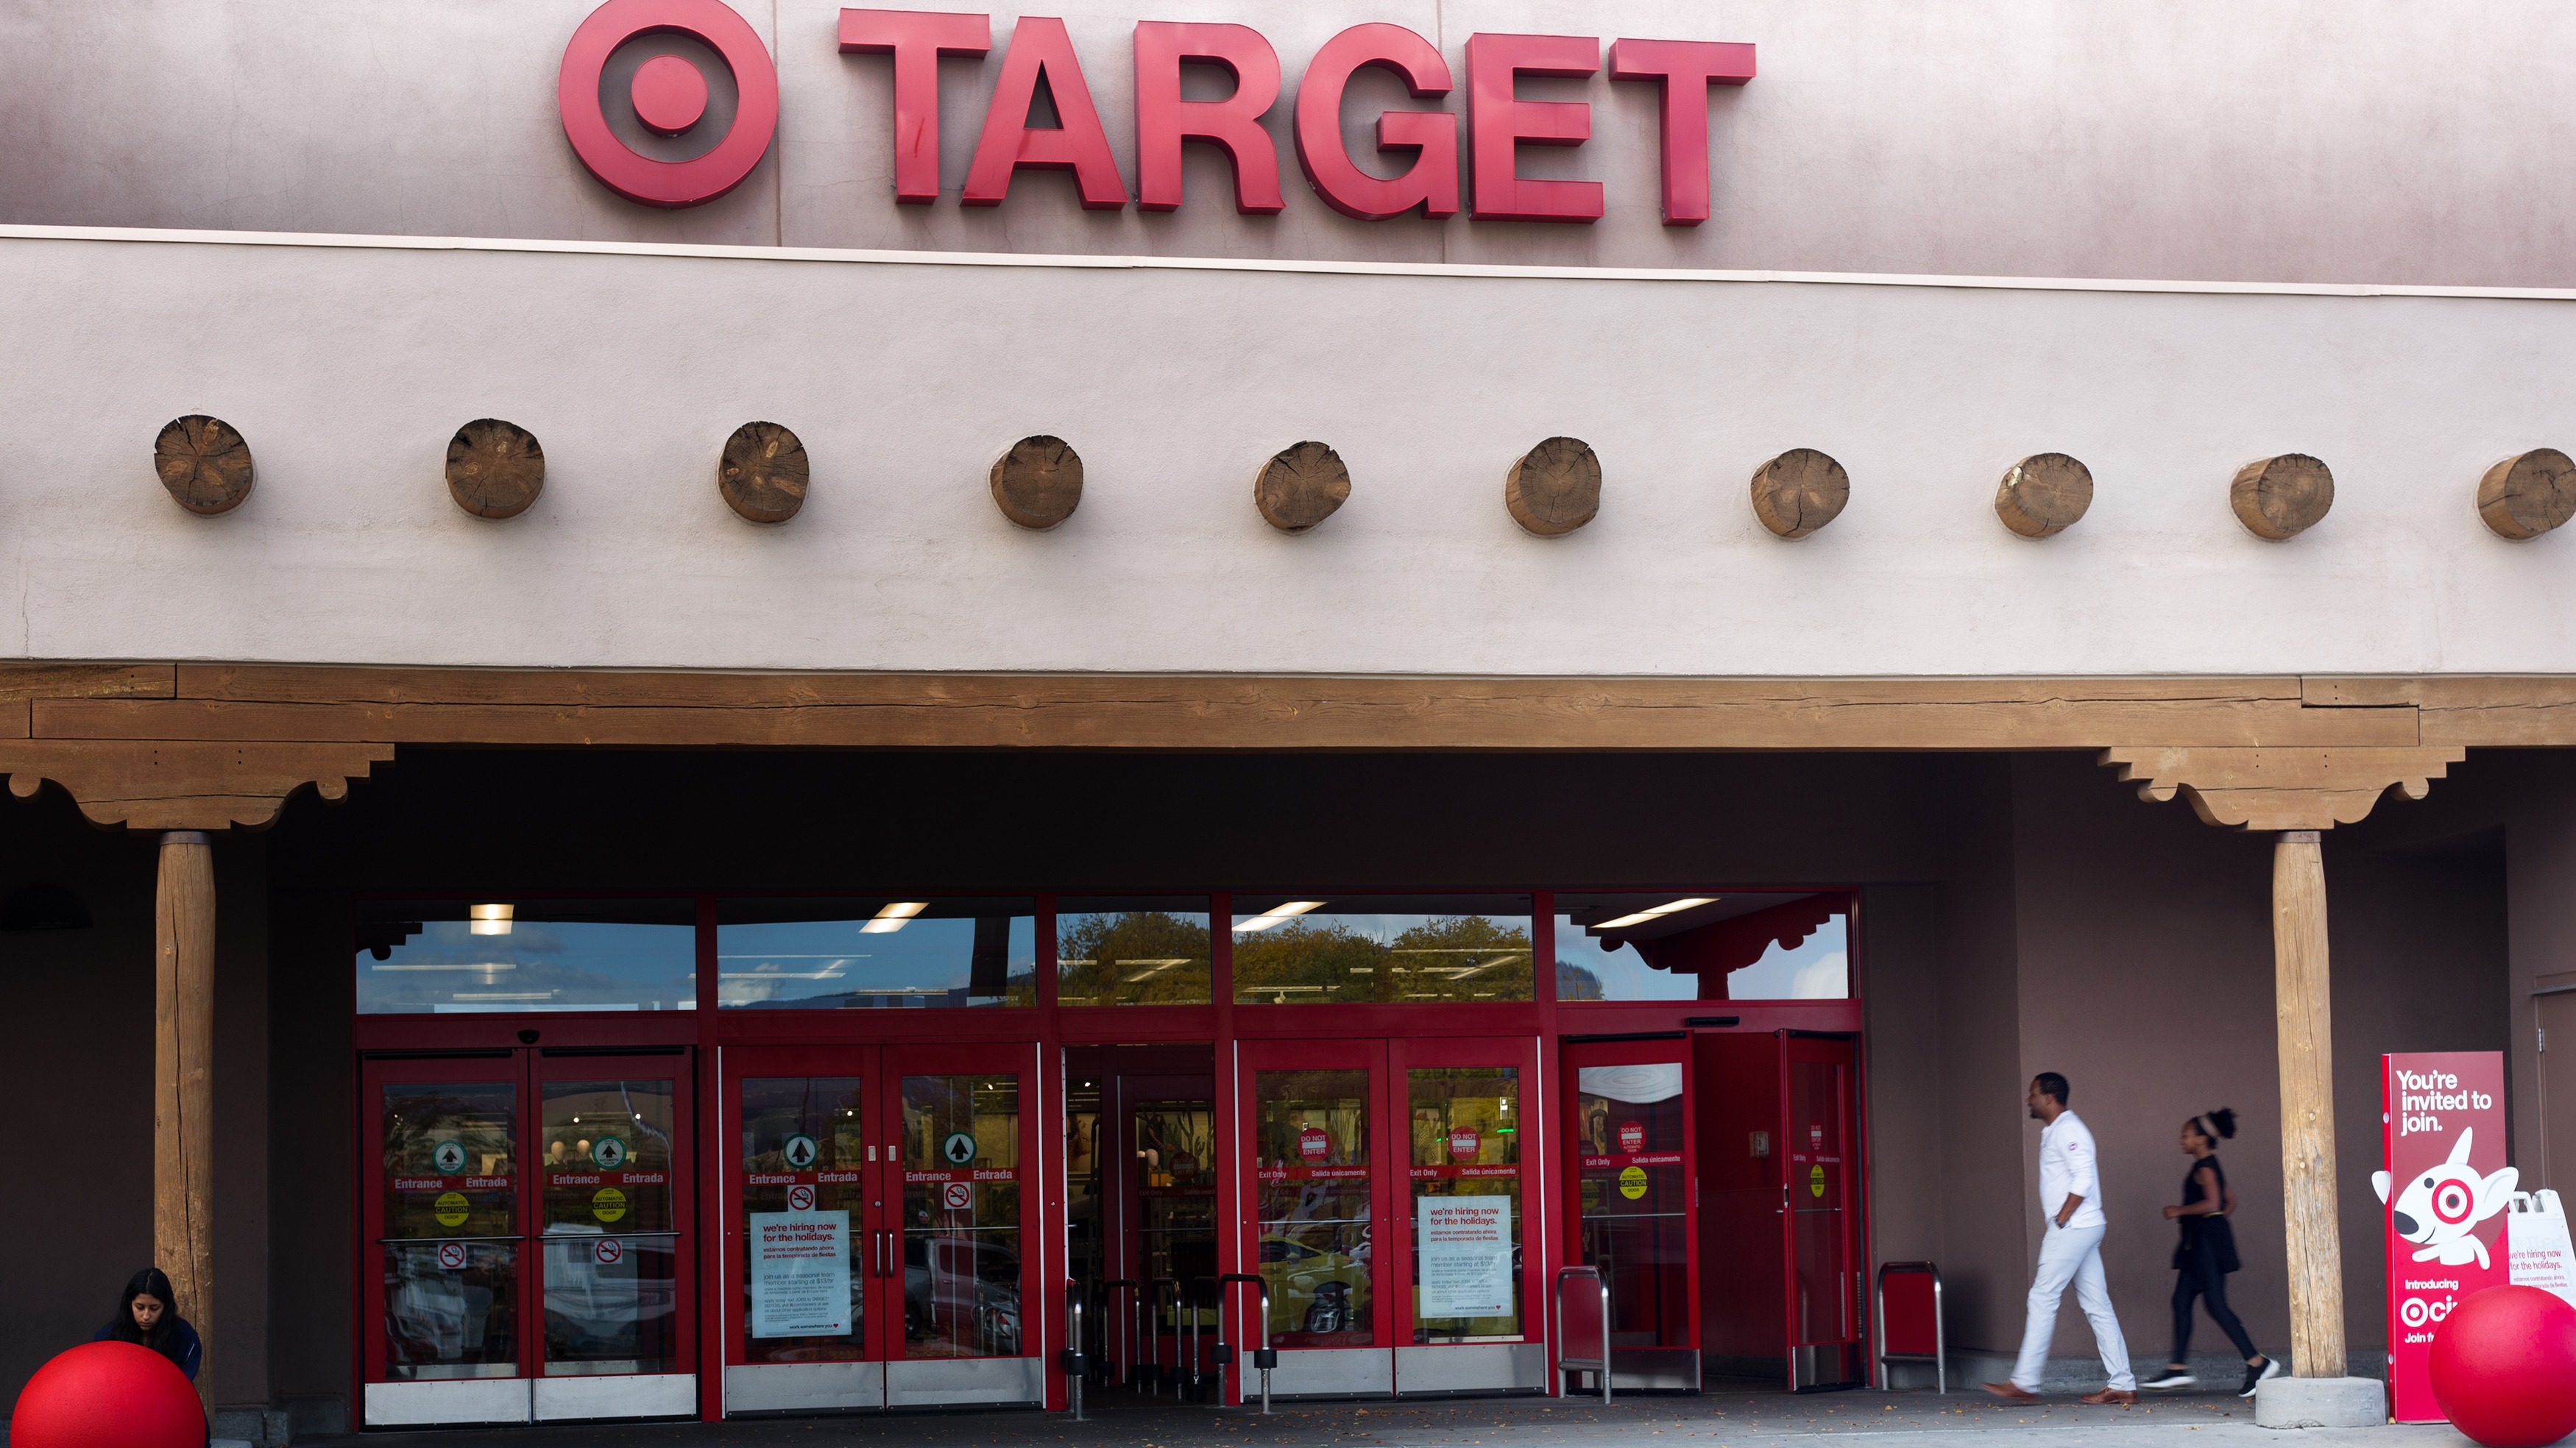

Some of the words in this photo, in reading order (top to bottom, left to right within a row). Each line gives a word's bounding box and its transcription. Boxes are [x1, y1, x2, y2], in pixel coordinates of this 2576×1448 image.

[838, 7, 1757, 226] TARGET
[2396, 1069, 2458, 1090] You're
[2402, 1090, 2468, 1111] invited
[2471, 1090, 2492, 1110] to
[2400, 1111, 2443, 1137] join.
[1598, 1158, 1610, 1166] Only
[749, 1174, 795, 1184] Entrance
[818, 1172, 857, 1182] Entrada
[906, 1171, 951, 1182] Entrance
[973, 1169, 1012, 1179] Entrada
[1273, 1171, 1287, 1179] Only
[1423, 1169, 1437, 1177] Only
[394, 1179, 442, 1188] Entrance
[466, 1177, 507, 1188] Entrada
[553, 1174, 600, 1185] Entrance
[623, 1173, 663, 1183] Entrada
[1430, 1207, 1453, 1215] we're
[1455, 1207, 1479, 1216] hiring
[1444, 1217, 1458, 1225] the
[1460, 1217, 1497, 1226] holidays.
[762, 1224, 788, 1232] we're
[790, 1223, 815, 1232] hiring
[763, 1234, 776, 1242] for
[778, 1233, 793, 1241] the
[796, 1232, 835, 1242] holidays.
[2527, 1249, 2546, 1260] hiring
[2510, 1262, 2519, 1271] for
[2521, 1261, 2532, 1270] the
[2533, 1260, 2563, 1271] holidays.
[2405, 1279, 2459, 1291] Introducing
[2405, 1332, 2426, 1344] Join
